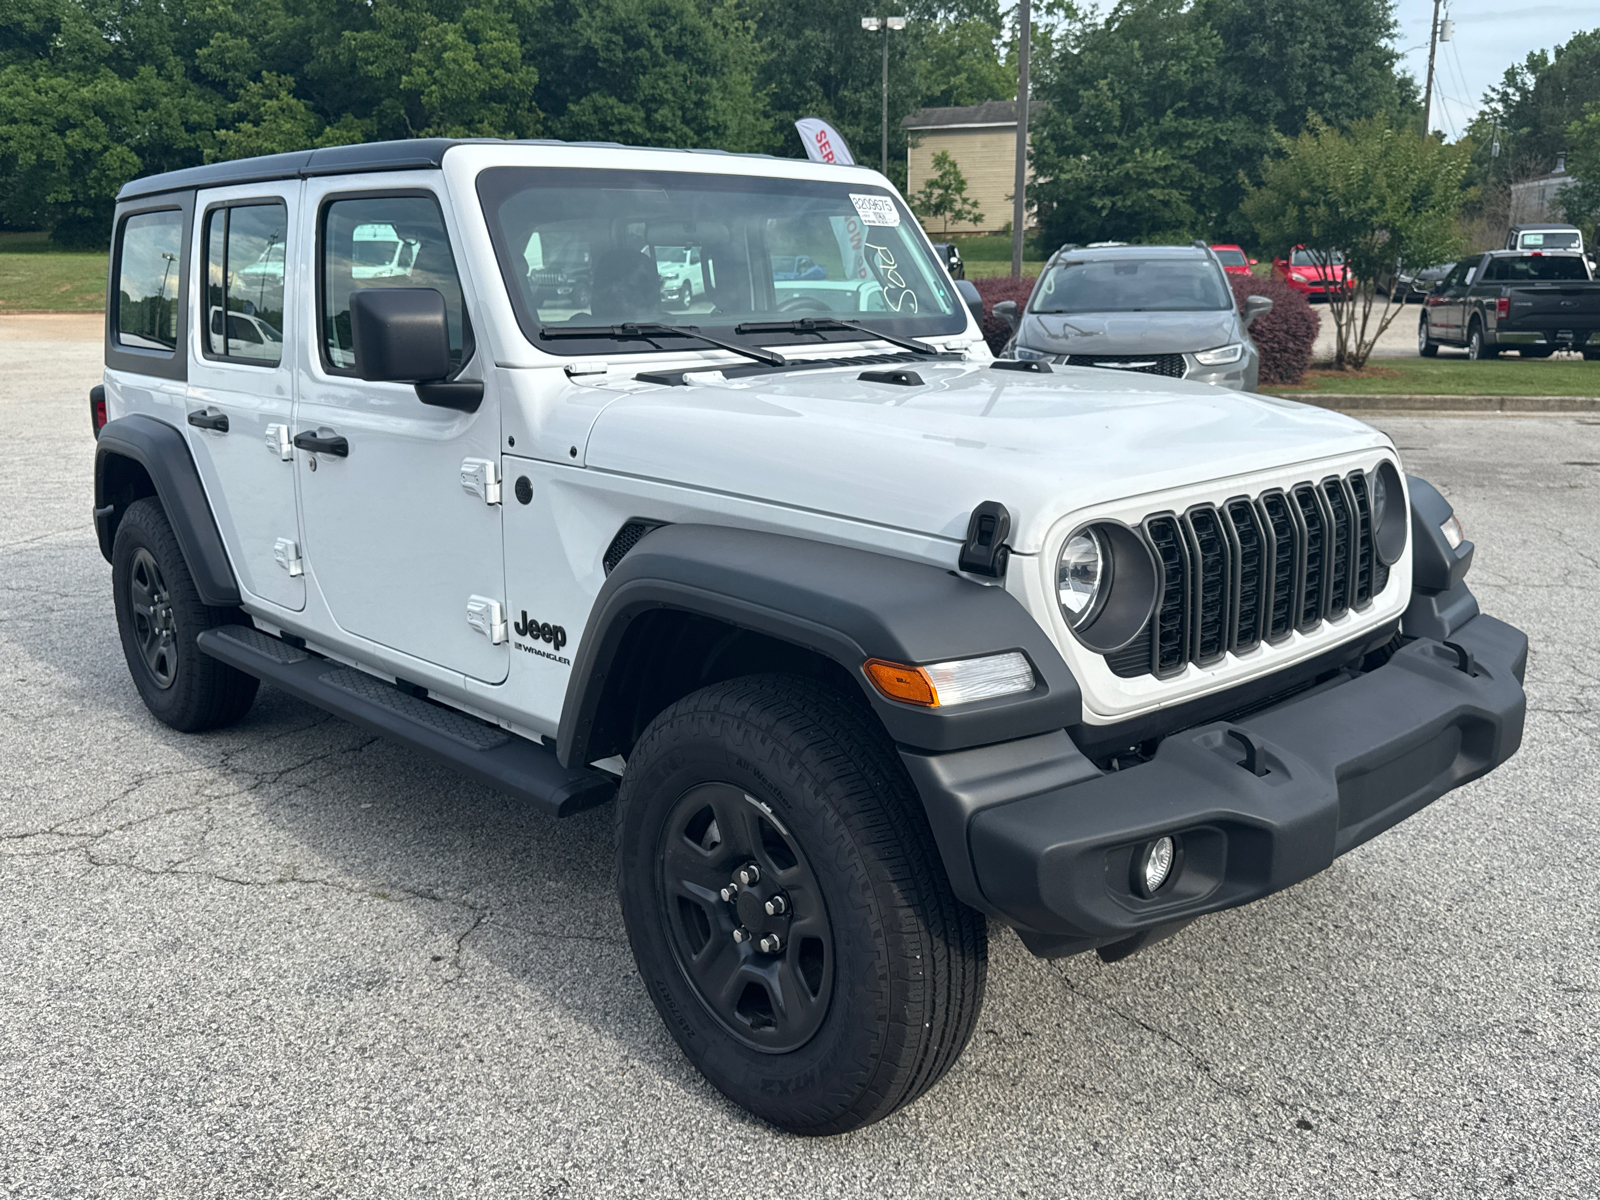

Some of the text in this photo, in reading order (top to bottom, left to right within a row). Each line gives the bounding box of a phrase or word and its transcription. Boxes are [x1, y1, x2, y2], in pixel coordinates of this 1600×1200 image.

[815, 129, 837, 164] SER
[514, 610, 567, 651] Jeep
[522, 644, 571, 666] WRANGLER
[736, 758, 793, 809] All-Weather
[656, 979, 694, 1039] 245/75R17
